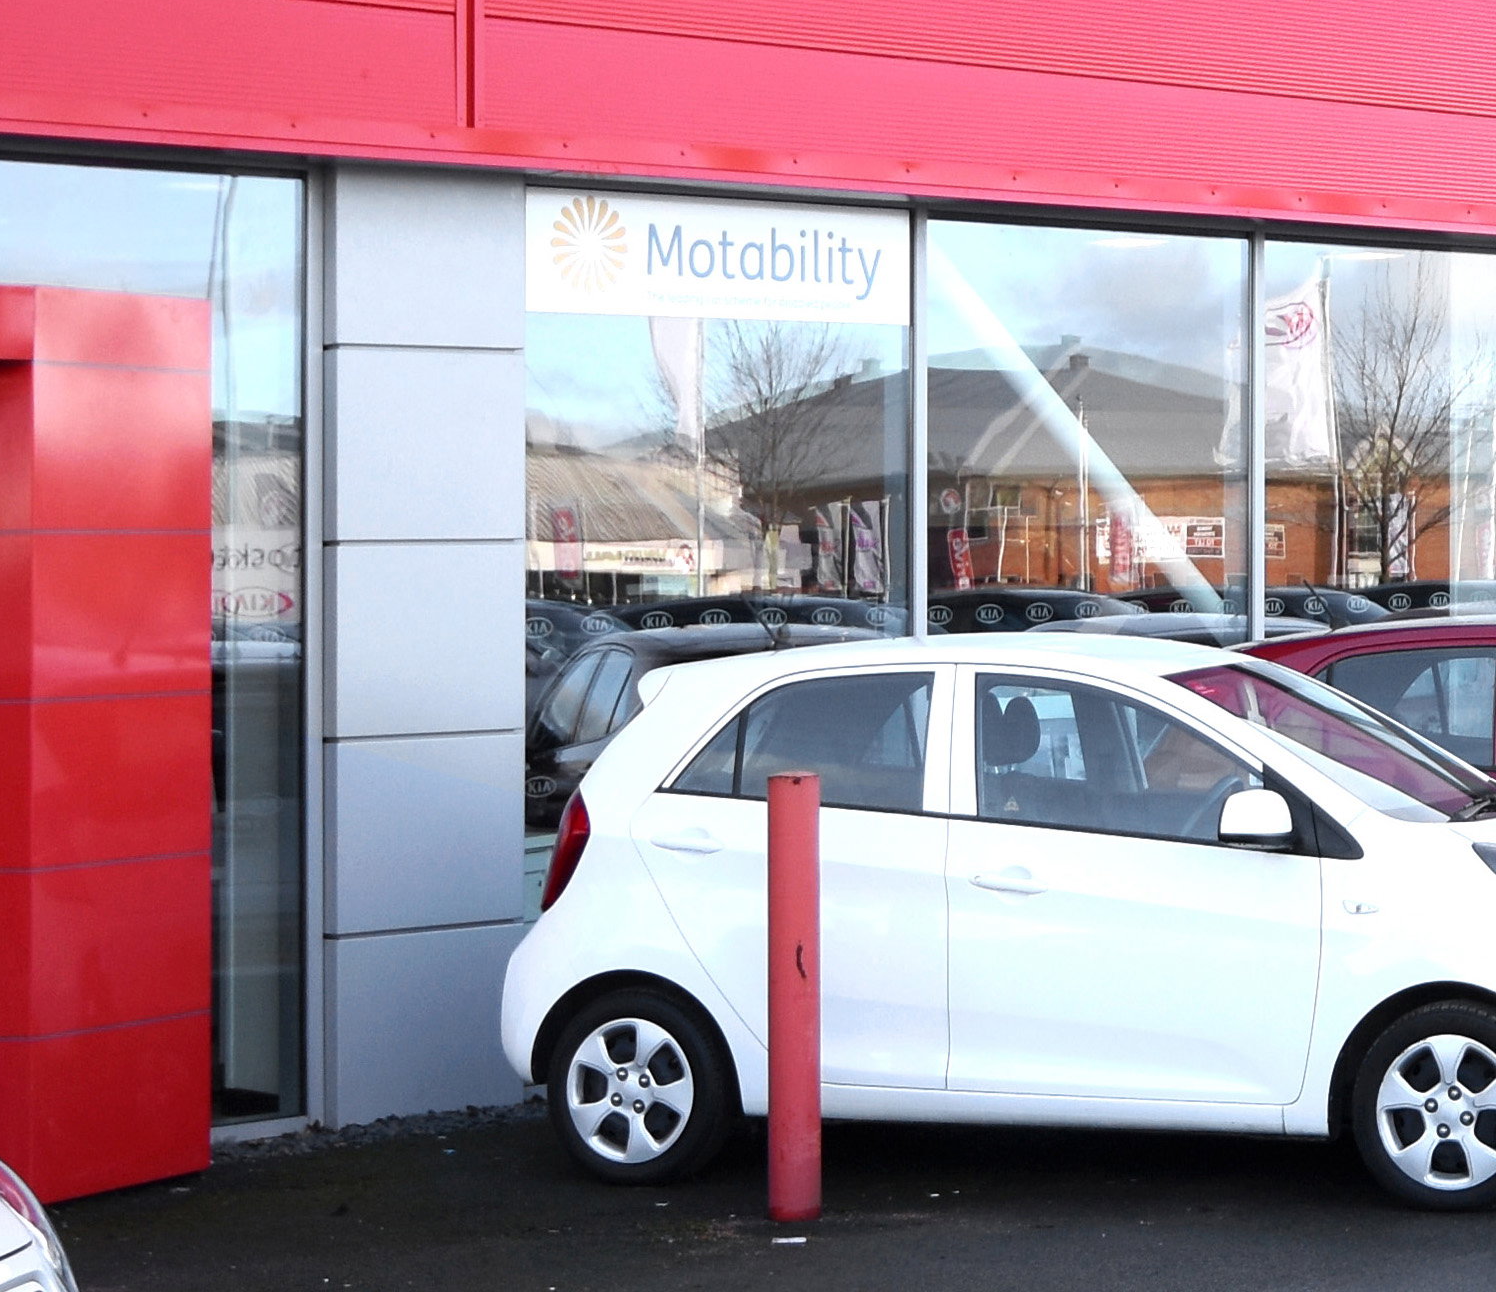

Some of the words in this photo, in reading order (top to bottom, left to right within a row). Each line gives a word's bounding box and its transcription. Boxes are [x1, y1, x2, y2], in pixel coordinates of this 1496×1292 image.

[647, 223, 881, 300] Motability
[1350, 599, 1367, 608] KIA
[1392, 598, 1408, 608] KIA
[1432, 596, 1449, 606] KIA
[929, 610, 949, 621] KIA
[981, 608, 1001, 619] KIA
[1030, 607, 1050, 618] KIA
[1079, 606, 1098, 616] KIA
[646, 615, 669, 627] KIA
[705, 613, 728, 625] KIA
[761, 612, 783, 623] KIA
[817, 612, 838, 623] KIA
[585, 618, 608, 631] KIA
[528, 780, 552, 793] KIA
